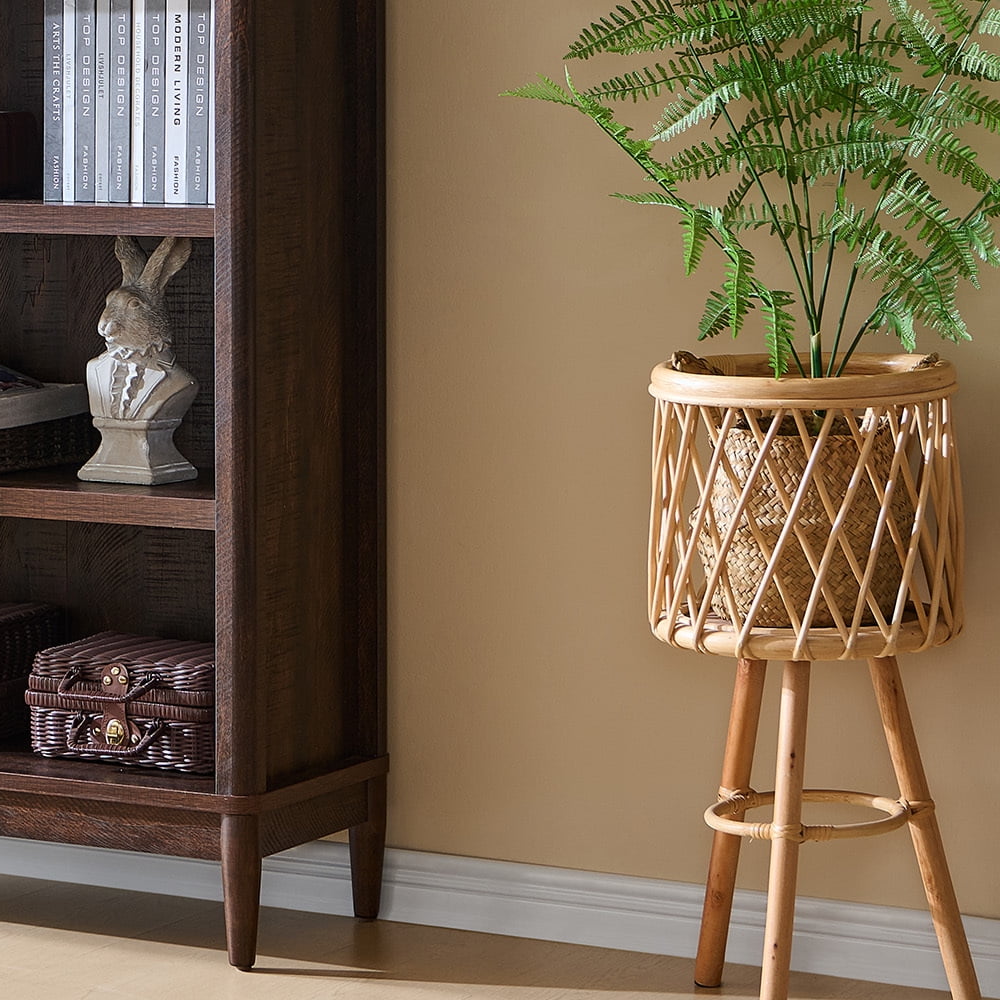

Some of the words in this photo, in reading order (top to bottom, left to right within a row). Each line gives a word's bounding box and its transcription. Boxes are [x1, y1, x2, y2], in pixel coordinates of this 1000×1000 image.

[52, 22, 60, 50] ARTS
[82, 14, 91, 46] TOP
[117, 13, 126, 46] TOP
[151, 14, 160, 46] TOP
[174, 14, 182, 72] MODERN
[196, 12, 205, 45] TOP
[52, 54, 61, 75] THE
[52, 78, 61, 121] CRAFTS
[82, 55, 91, 117] DESIGN
[117, 55, 126, 117] DESIGN
[151, 55, 160, 117] DESIGN
[196, 54, 205, 117] DESIGN
